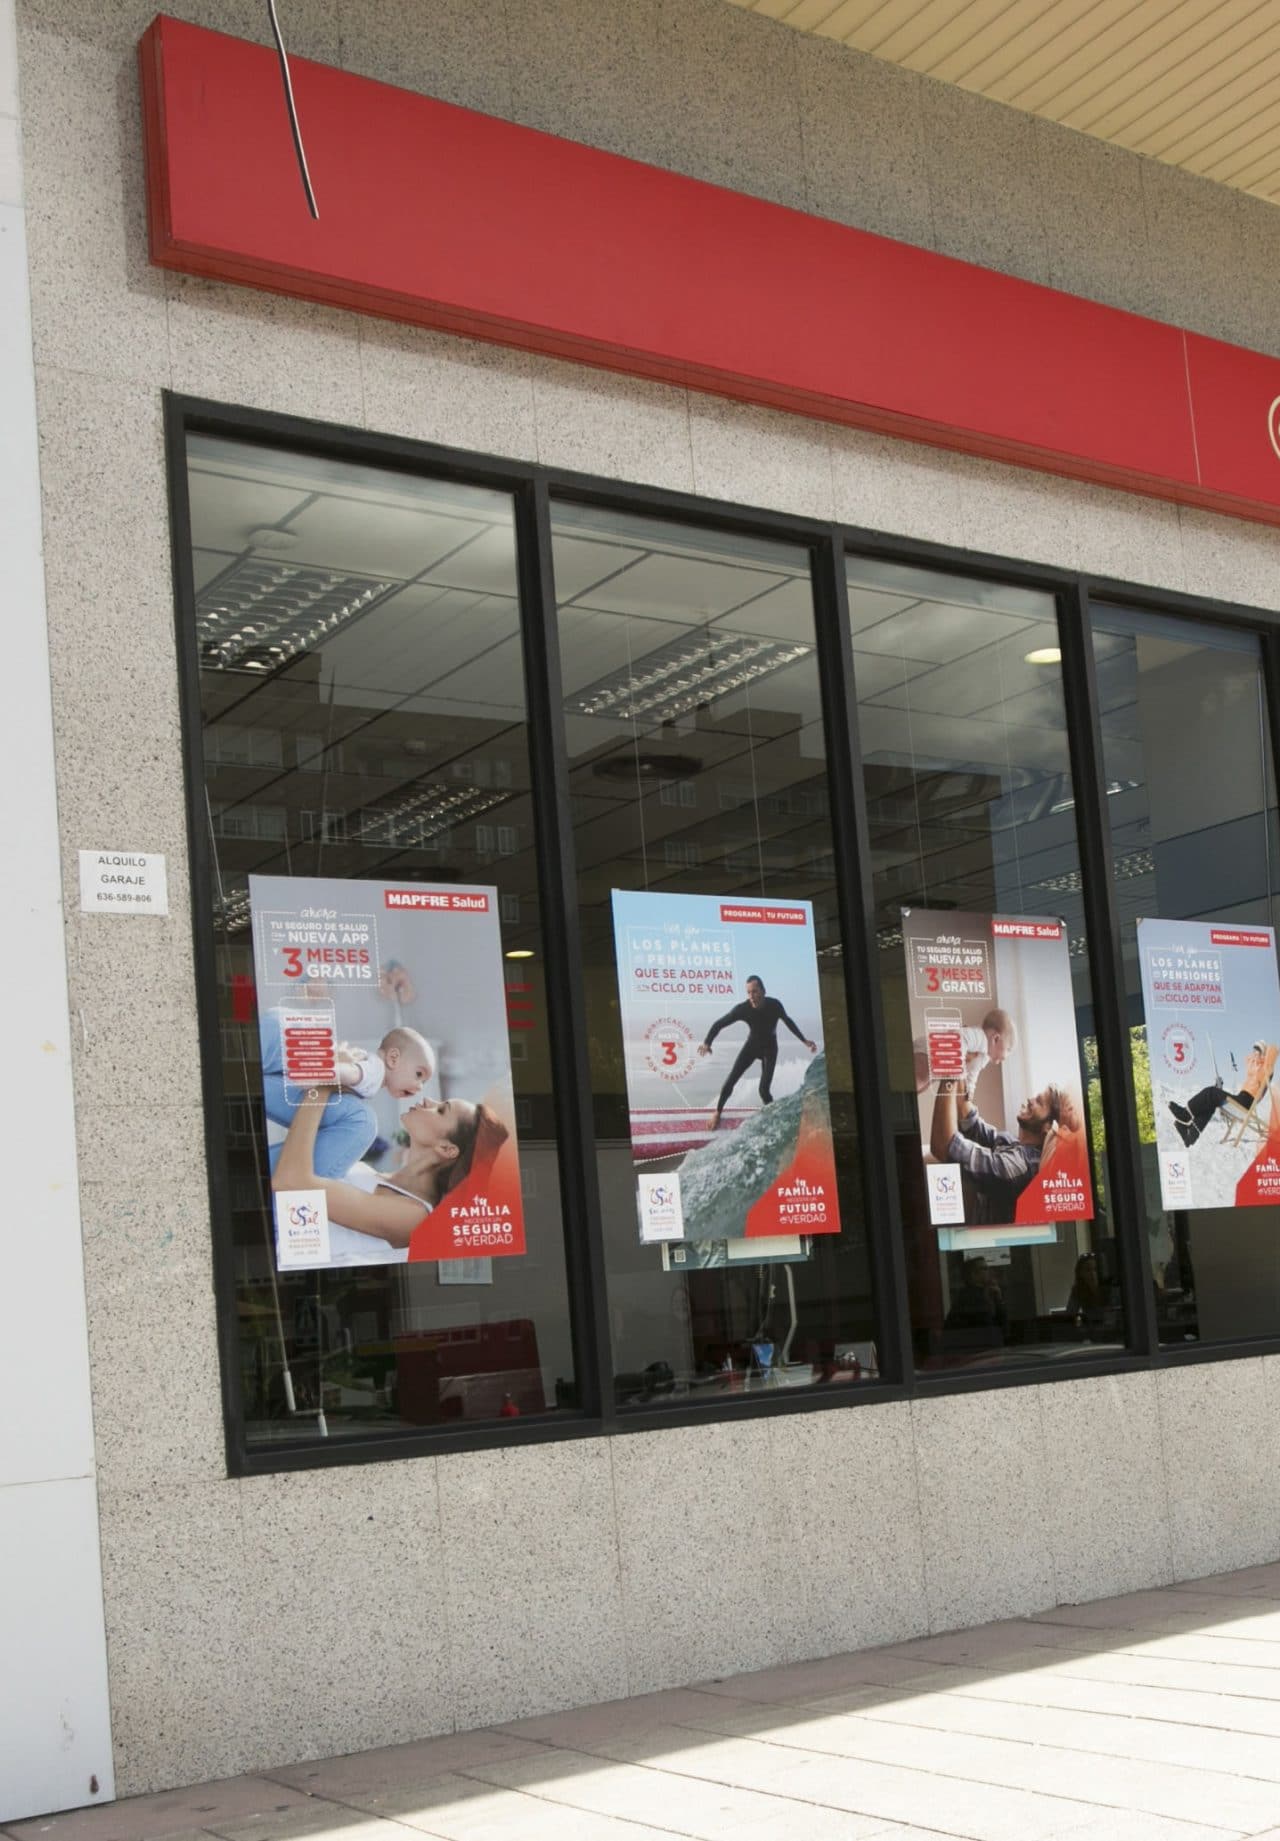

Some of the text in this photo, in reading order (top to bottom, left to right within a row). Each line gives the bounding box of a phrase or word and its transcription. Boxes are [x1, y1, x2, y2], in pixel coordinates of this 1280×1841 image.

[98, 856, 146, 867] ALQUILO
[101, 874, 145, 885] GARAJE
[388, 893, 486, 908] MAPFRE Salud
[723, 910, 762, 918] PROGRAMA
[766, 911, 776, 919] TU
[271, 921, 368, 932] TU SEGURO DE SALUD
[994, 924, 1059, 937] MAPFRE Salud
[288, 931, 338, 944] NUEVA
[342, 932, 369, 945] APP
[633, 939, 731, 952] LOS PLANES
[281, 947, 304, 977] 3
[307, 948, 369, 963] MESES
[648, 954, 732, 967] PENSIONES
[928, 954, 962, 965] NUEVA
[964, 956, 983, 966] APP
[1151, 958, 1219, 970] LOS PLANES
[307, 964, 372, 978] GRATIS
[634, 968, 733, 980] QUE SE ADAPTAN
[1162, 969, 1220, 981] PENSIONES
[925, 967, 940, 992] 3
[941, 967, 984, 980] MESES
[651, 983, 685, 993] CICLO
[688, 983, 703, 993] DE
[707, 984, 734, 994] VIDA
[942, 980, 986, 993] GRATIS
[1153, 982, 1170, 990] QUE
[1184, 983, 1222, 992] ADAPTAN
[1042, 1178, 1083, 1189] FAMILIA
[777, 1185, 824, 1197] FAMILIA
[1044, 1192, 1085, 1203] SEGURO
[450, 1204, 511, 1218] FAMILIA
[779, 1202, 826, 1214] FUTURO
[787, 1213, 827, 1224] VERDAD
[452, 1222, 512, 1236] SEGURO
[464, 1233, 513, 1246] VERDAD
